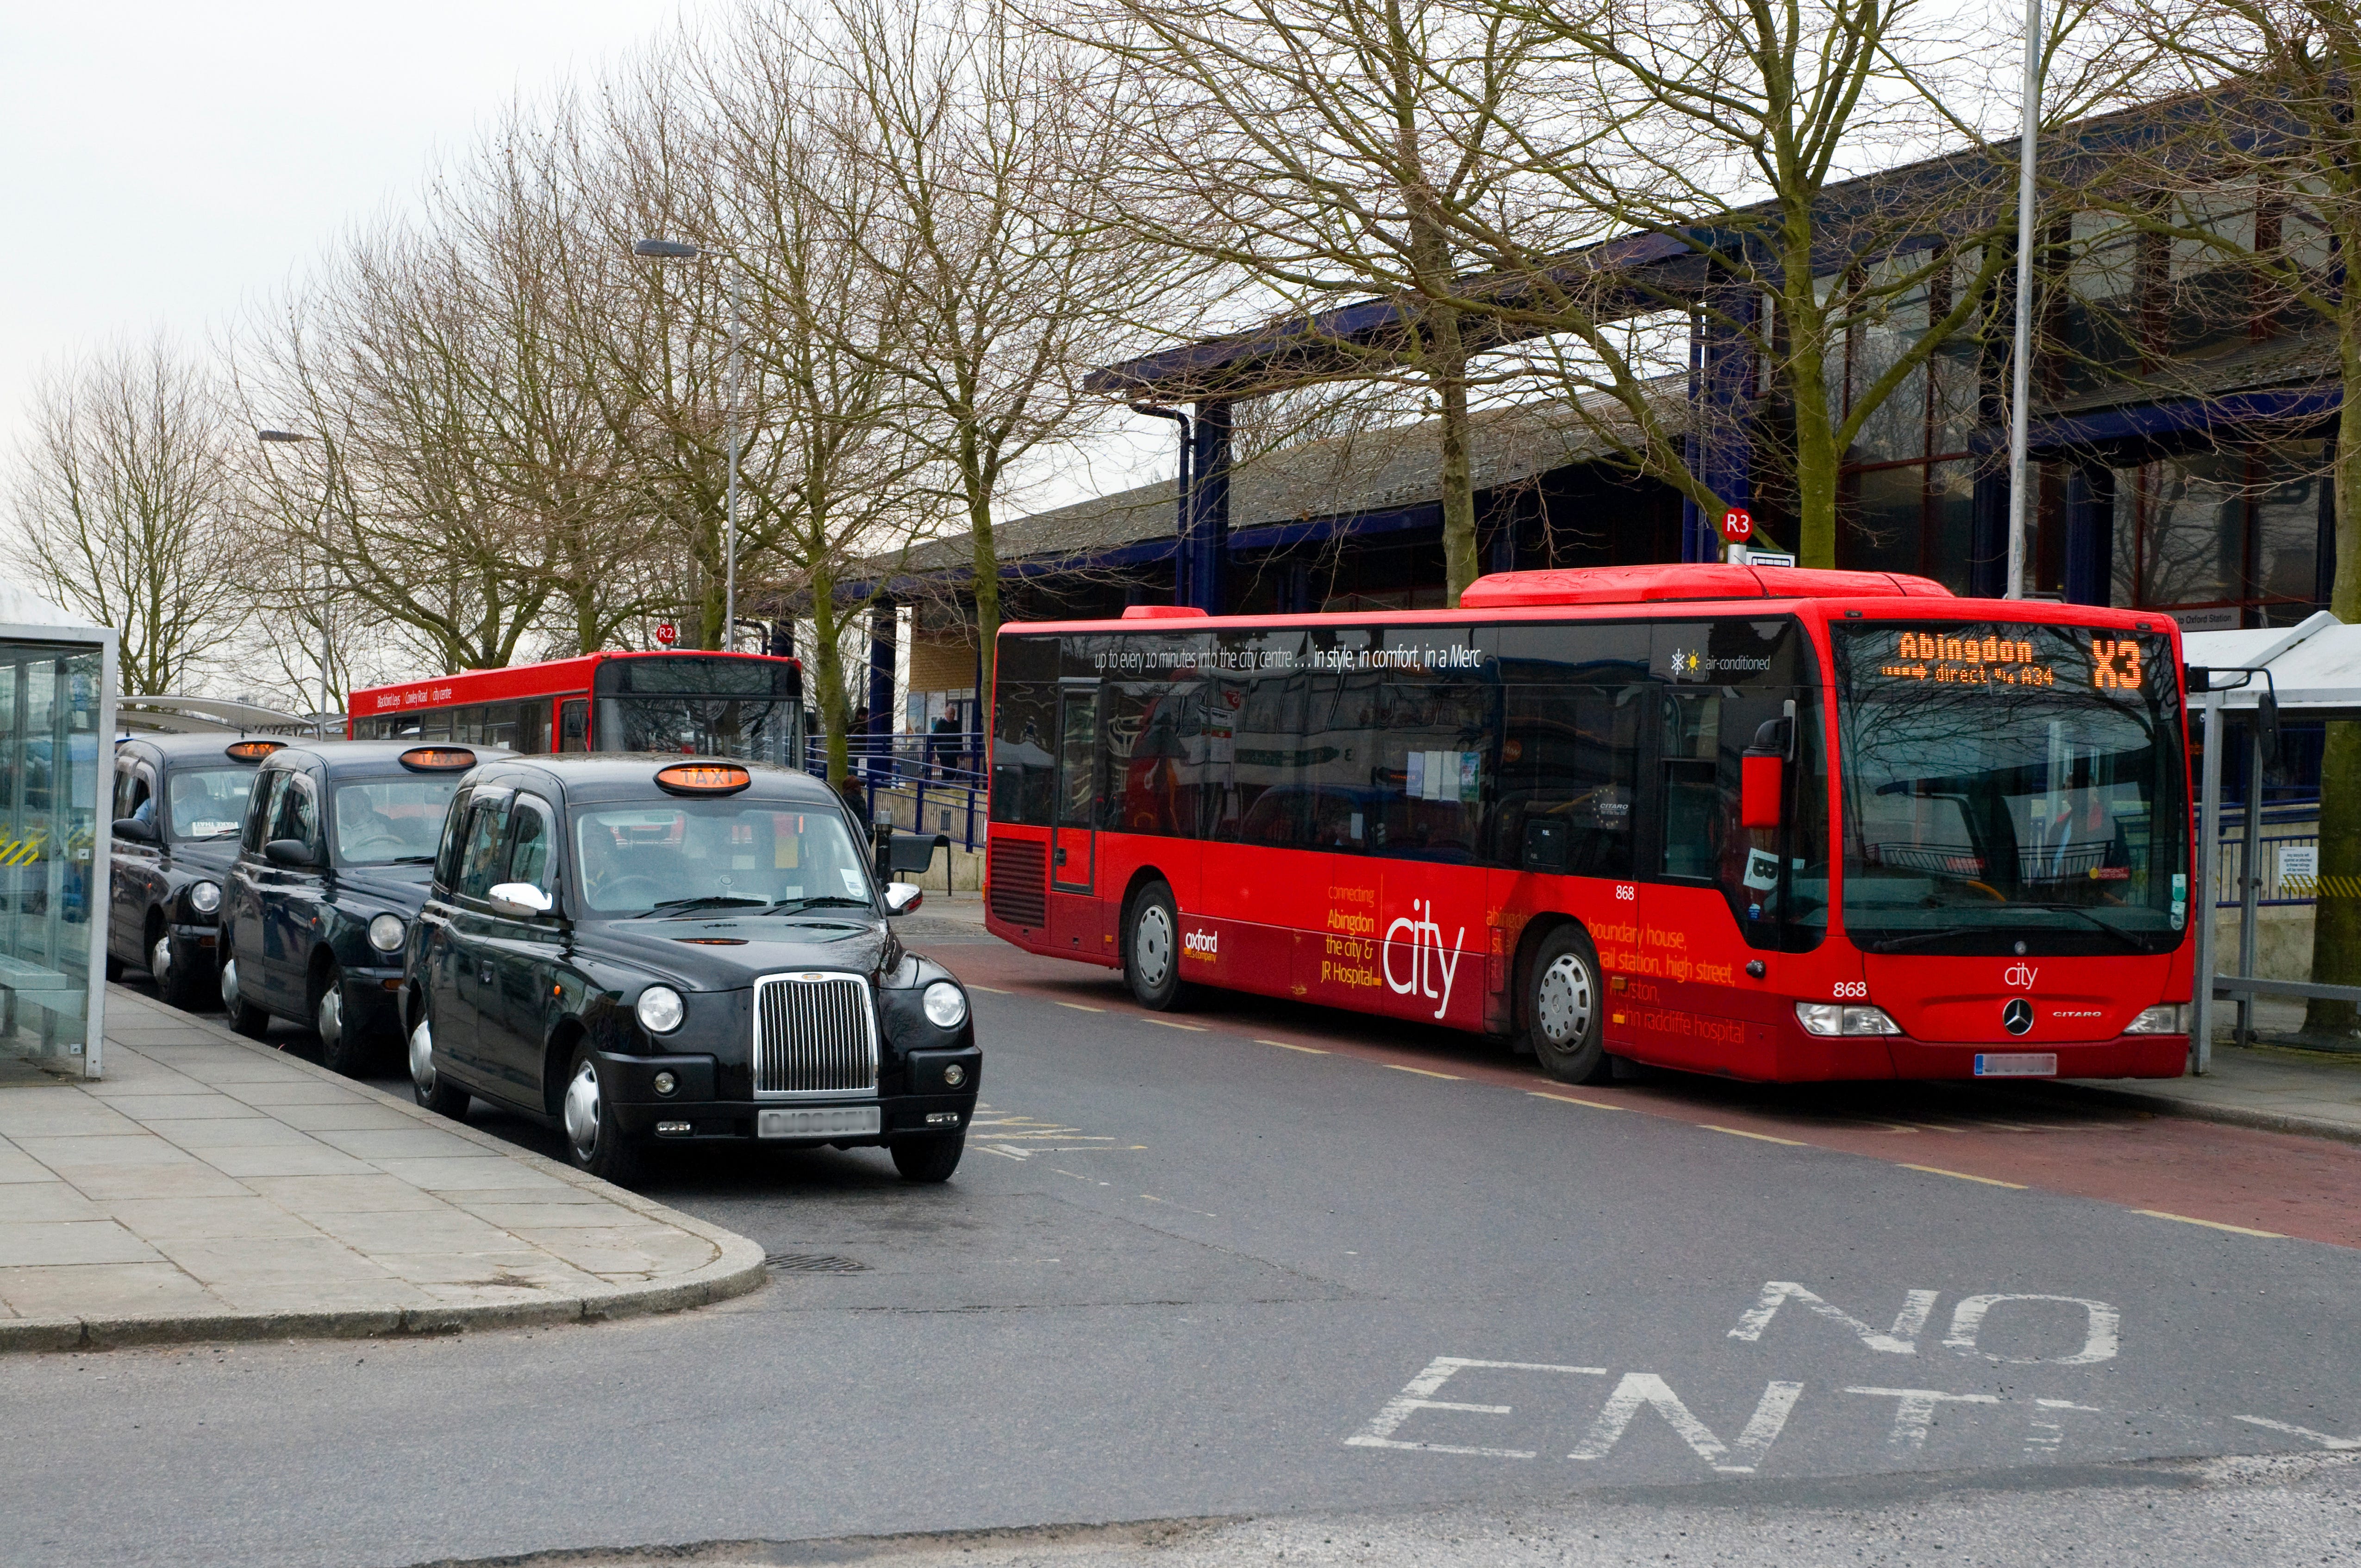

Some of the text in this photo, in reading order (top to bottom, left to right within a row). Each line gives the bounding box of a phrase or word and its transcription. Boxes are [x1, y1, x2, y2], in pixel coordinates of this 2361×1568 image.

[1727, 513, 1749, 533] R3
[2186, 614, 2208, 624] Oxford
[2209, 613, 2232, 623] Station
[659, 627, 674, 638] R2
[1094, 653, 1106, 674] up
[1108, 649, 1118, 668] to
[1119, 652, 1144, 674] every
[1145, 653, 1157, 668] 10
[1158, 646, 1196, 668] minutes
[1199, 646, 1218, 668] into
[1219, 646, 1237, 668] the
[1239, 645, 1258, 674] city
[1259, 646, 1292, 668] centre
[1314, 644, 1324, 668] in
[1326, 643, 1355, 674] style,
[1359, 643, 1369, 668] in
[1372, 643, 1420, 671] comfort,
[1424, 643, 1435, 668] in
[1438, 649, 1447, 668] a
[1449, 644, 1481, 668] Merc
[1900, 632, 2032, 663] Abingdon
[1705, 655, 1770, 670] air-conditioned
[1936, 663, 1988, 684] direct
[2021, 666, 2054, 686] A34
[2092, 639, 2142, 689] X3
[405, 690, 418, 706] Cowley
[418, 688, 428, 703] Road
[440, 686, 452, 700] centre
[421, 751, 463, 764] TAXI
[680, 769, 733, 784] TAXI
[1328, 884, 1375, 908] connecting
[1615, 884, 1635, 901] 868
[1327, 908, 1374, 931] Abingdon
[1185, 928, 1218, 953] oxford
[1588, 917, 1686, 951] boundary house,
[1195, 951, 1217, 964] company
[1325, 934, 1374, 963] the city &
[1383, 898, 1465, 1019] city
[1320, 960, 1373, 989] JR Hospital
[1618, 950, 1661, 977] station,
[1666, 954, 1693, 983] high
[1696, 960, 1735, 987] street,
[2004, 962, 2038, 990] city
[1833, 981, 1867, 997] 868
[1644, 1009, 1691, 1035] radcliffe
[1694, 1014, 1744, 1046] hospital
[1727, 1281, 2120, 1364] NO
